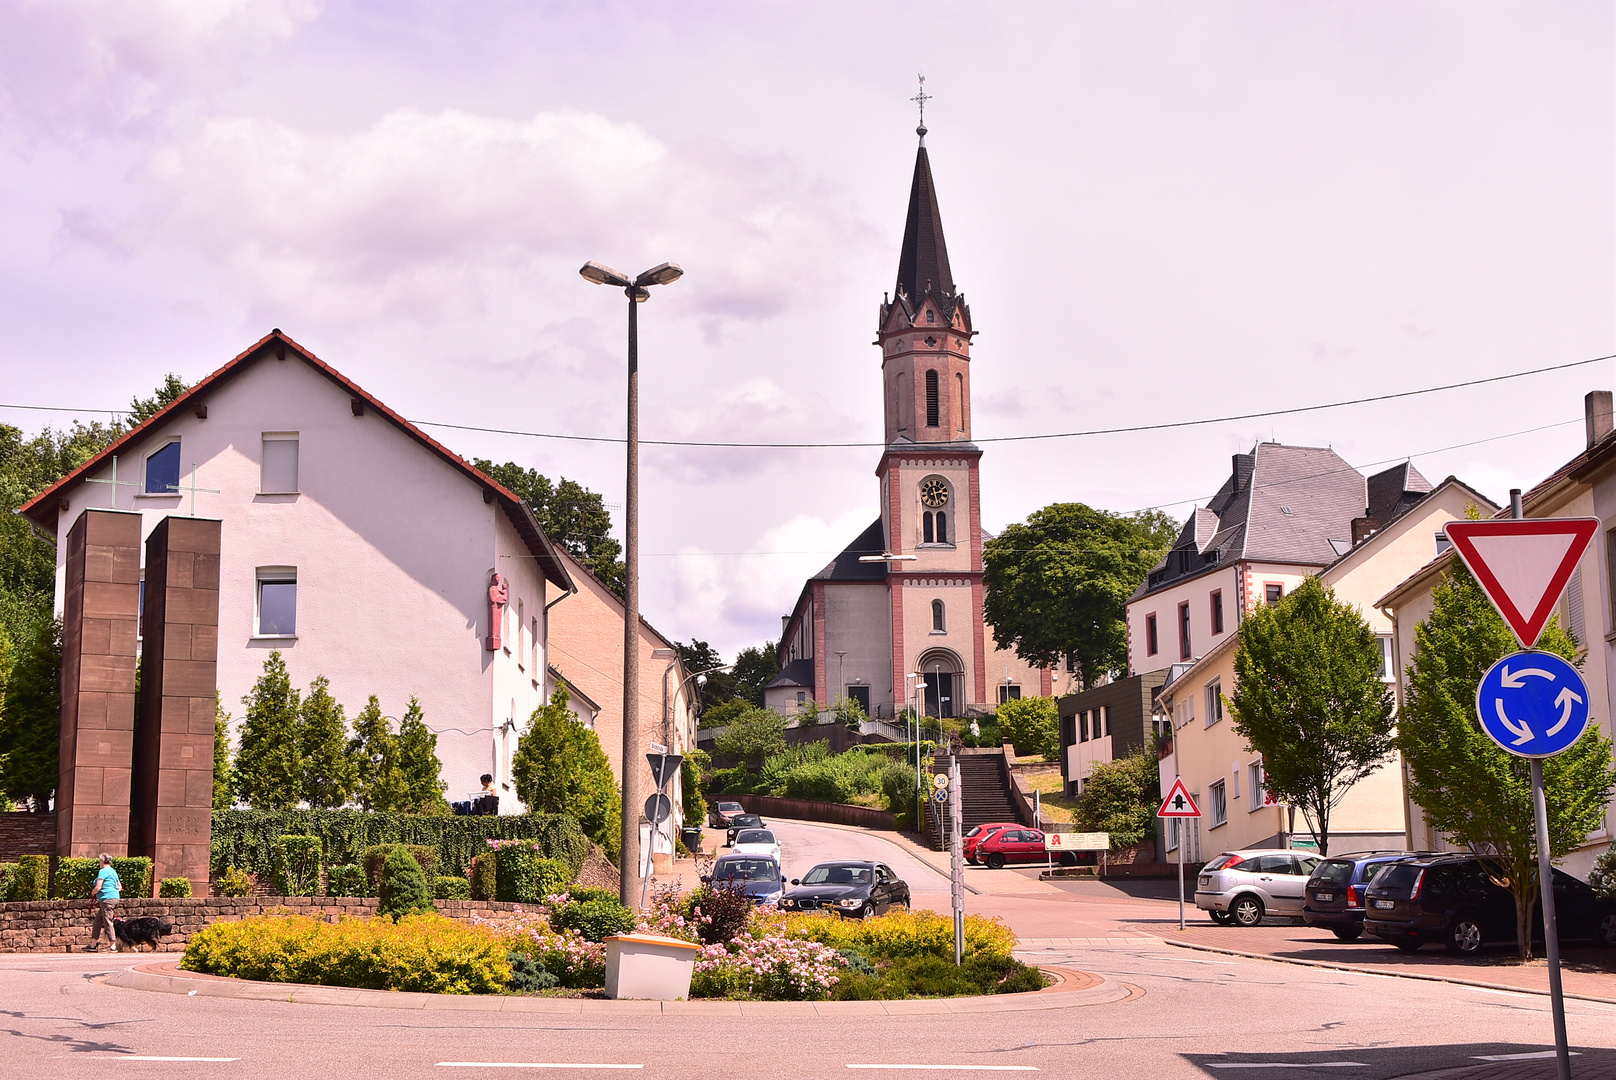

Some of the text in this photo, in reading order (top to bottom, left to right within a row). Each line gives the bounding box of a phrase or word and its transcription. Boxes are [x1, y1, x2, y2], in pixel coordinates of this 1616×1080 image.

[936, 777, 946, 785] 30
[169, 815, 200, 824] 1939
[86, 825, 115, 834] 1918
[168, 826, 200, 836] 1945
